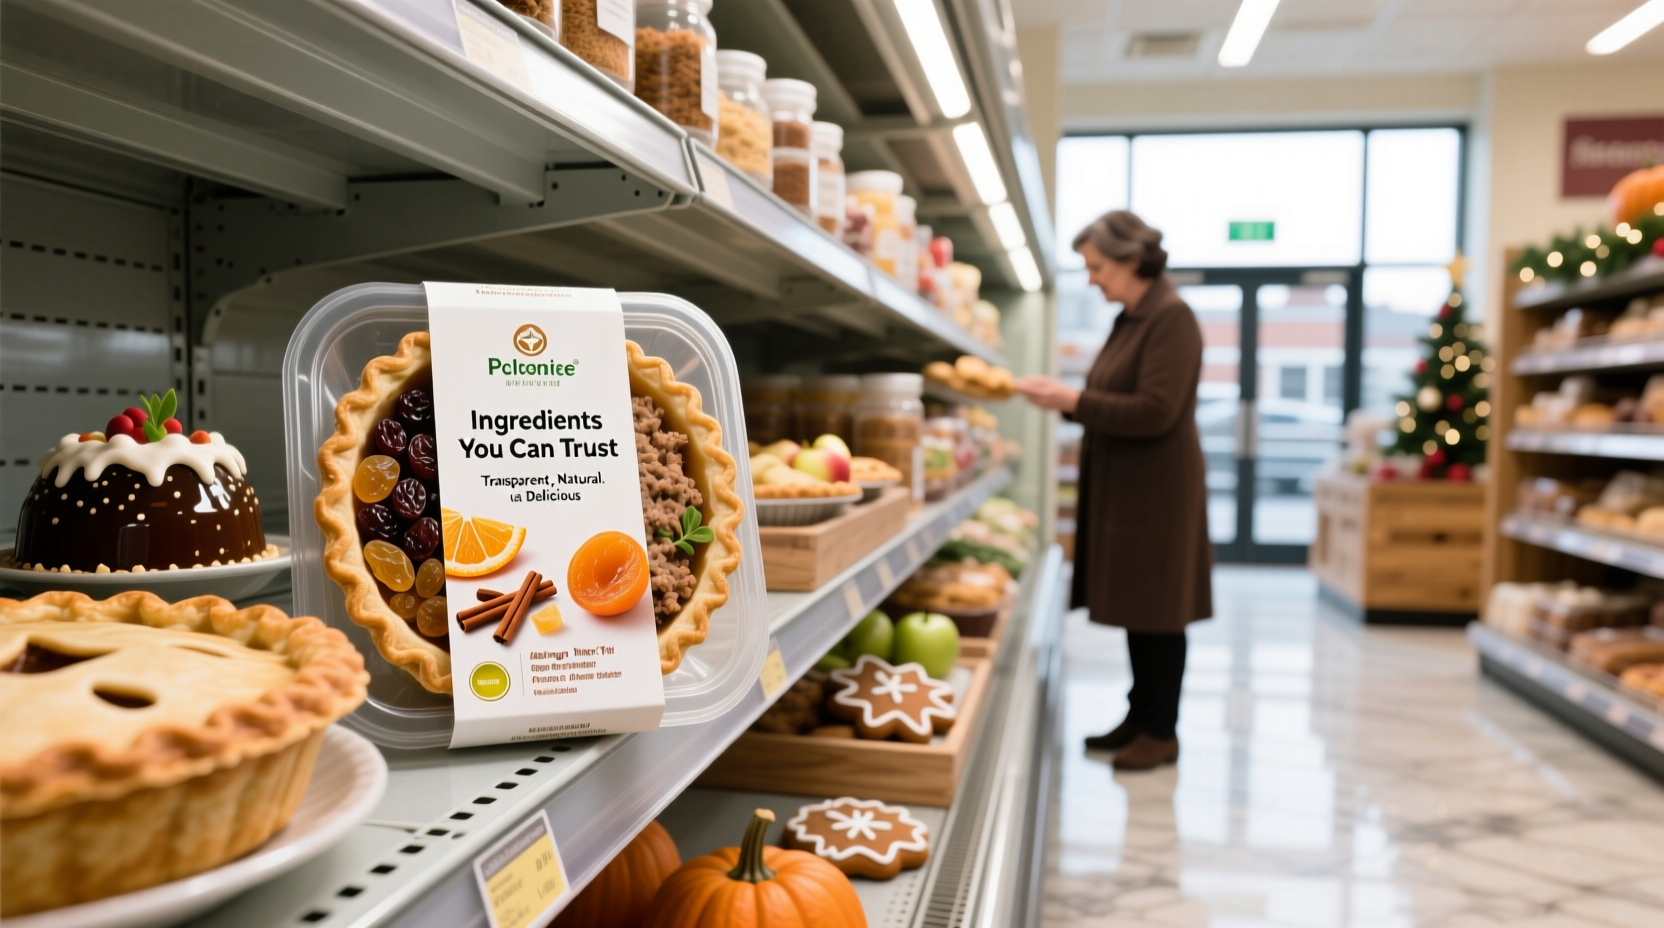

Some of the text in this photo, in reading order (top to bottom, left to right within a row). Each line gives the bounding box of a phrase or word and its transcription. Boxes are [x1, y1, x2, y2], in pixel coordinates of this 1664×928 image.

[471, 409, 603, 436] Ingredients
[458, 438, 619, 459] You Can Trust
[525, 488, 581, 502] Delicious
